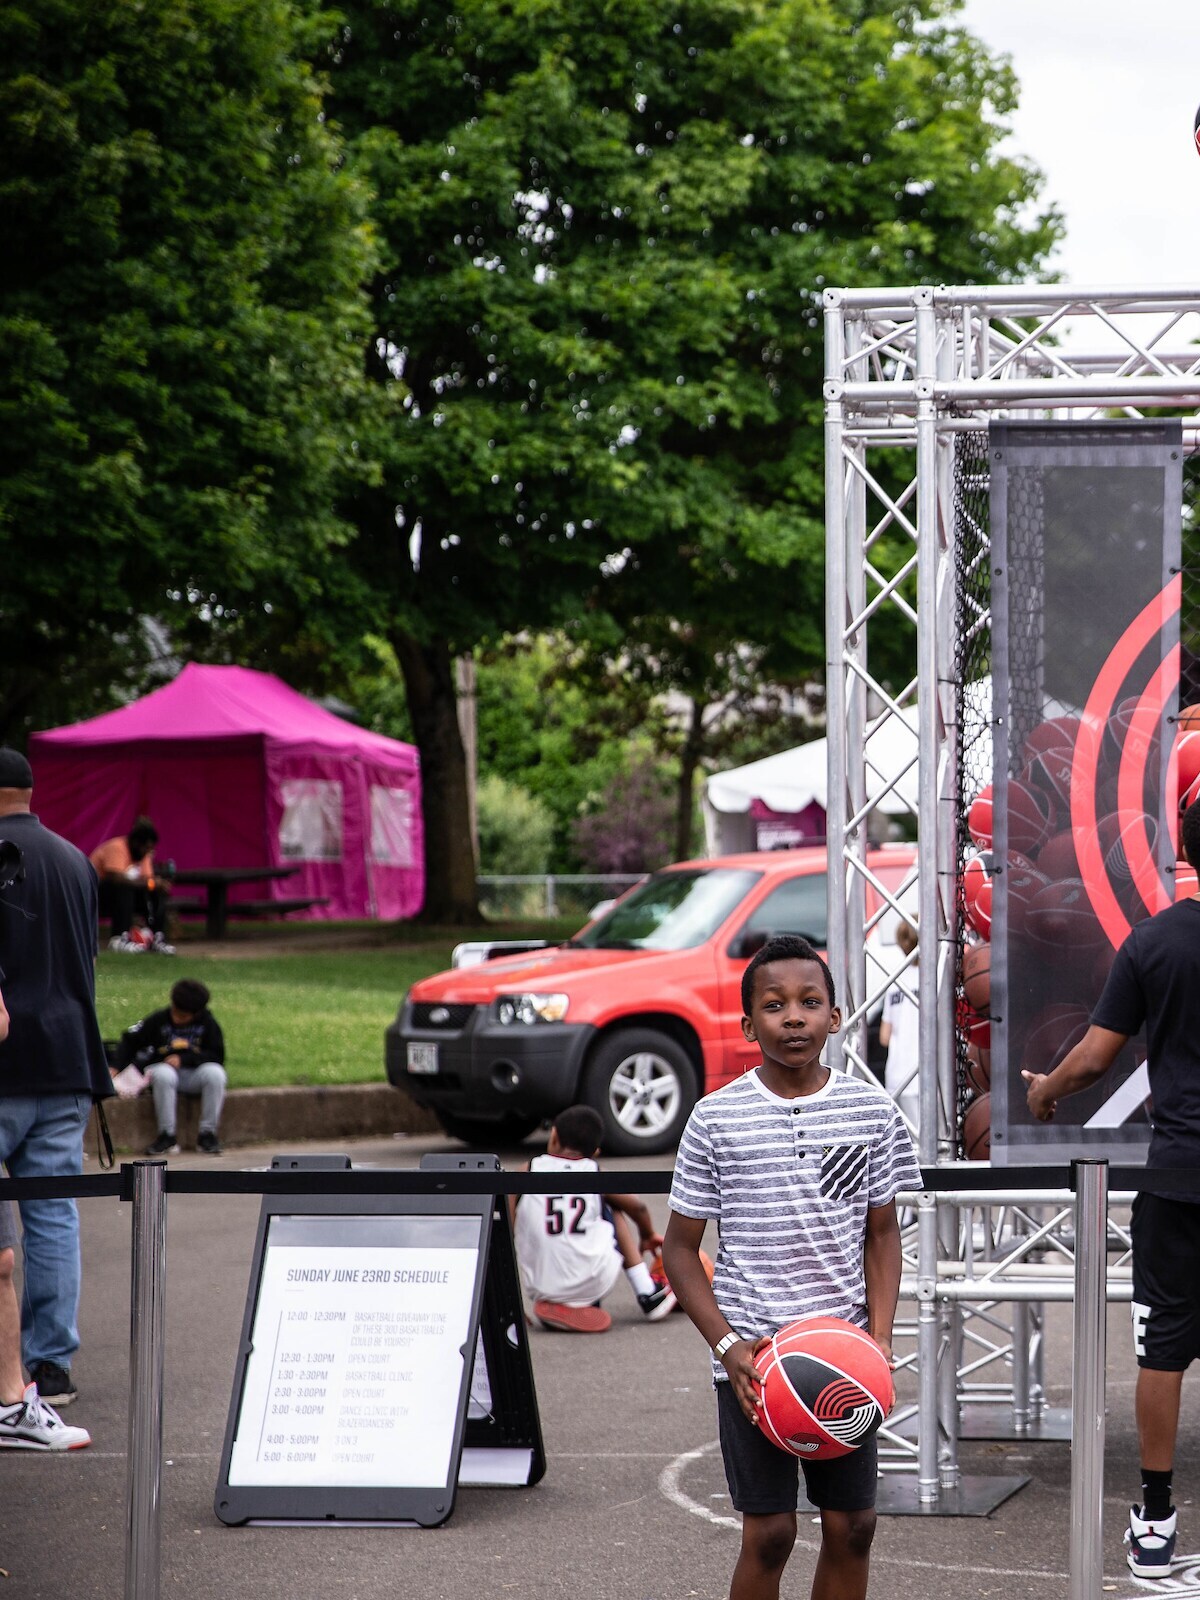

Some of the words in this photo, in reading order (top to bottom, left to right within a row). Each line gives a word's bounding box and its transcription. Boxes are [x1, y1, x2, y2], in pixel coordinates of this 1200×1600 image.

[545, 1195, 586, 1235] 52
[286, 1269, 331, 1282] SUNDAY
[332, 1269, 360, 1283] JUNE
[361, 1270, 391, 1283] 23RD
[393, 1270, 449, 1284] SCHEDULE
[287, 1311, 308, 1321] 12:00
[314, 1311, 346, 1321] 12:30PM
[354, 1311, 395, 1322] BASKETBALL
[399, 1324, 445, 1335] BASKETBALLS
[280, 1352, 301, 1363] 12:30
[307, 1353, 335, 1363] 1:30PM
[367, 1353, 390, 1364] COURT
[278, 1369, 294, 1380] 1:30
[299, 1370, 328, 1380] 2:30PM
[345, 1371, 387, 1381] BASKETBALL
[274, 1387, 292, 1397] 2:30
[296, 1387, 326, 1398] 3:00PM
[271, 1404, 290, 1414] 3:00
[295, 1404, 324, 1415] 4:00PM
[266, 1434, 285, 1444] 4:00
[290, 1434, 319, 1445] 5:00PM
[263, 1451, 281, 1462] 5:00
[286, 1451, 316, 1462] 6:00PM
